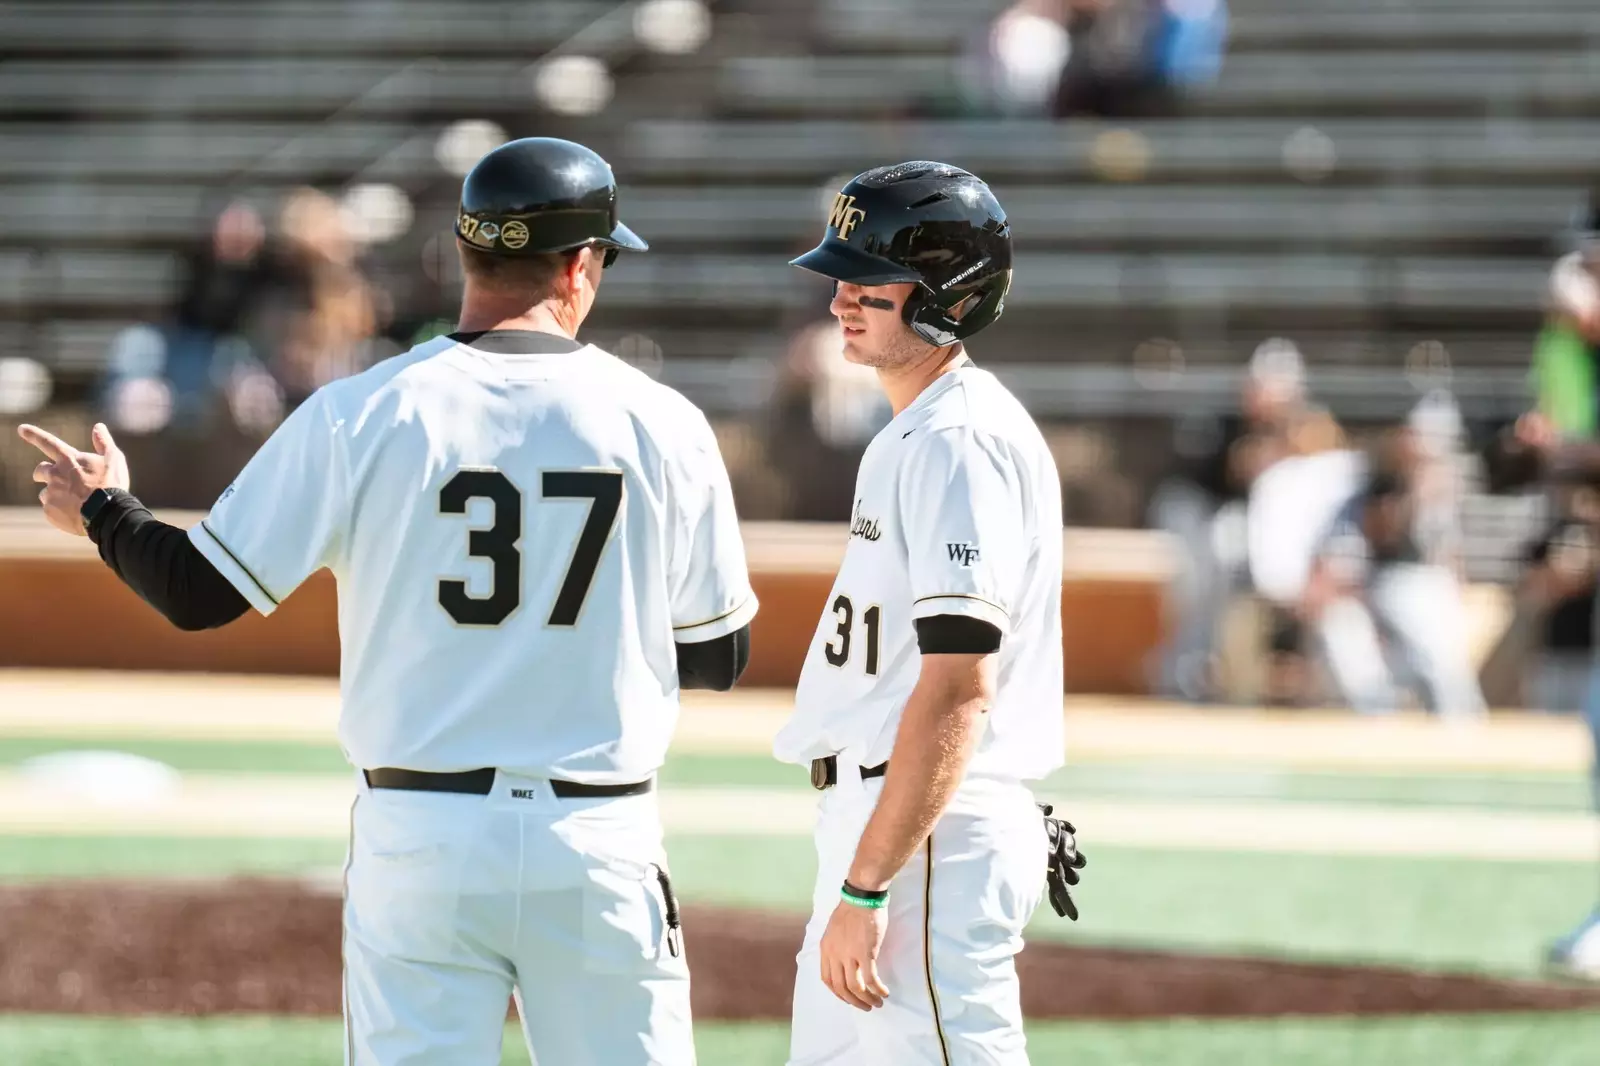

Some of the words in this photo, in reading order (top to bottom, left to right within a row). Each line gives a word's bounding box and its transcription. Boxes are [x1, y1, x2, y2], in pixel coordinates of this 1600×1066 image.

[460, 214, 479, 237] 37
[828, 192, 866, 241] WF
[941, 261, 984, 290] EVOSHIELD
[437, 465, 627, 630] 37
[946, 543, 979, 567] WF
[824, 593, 882, 678] 31
[511, 788, 535, 800] WAKE
